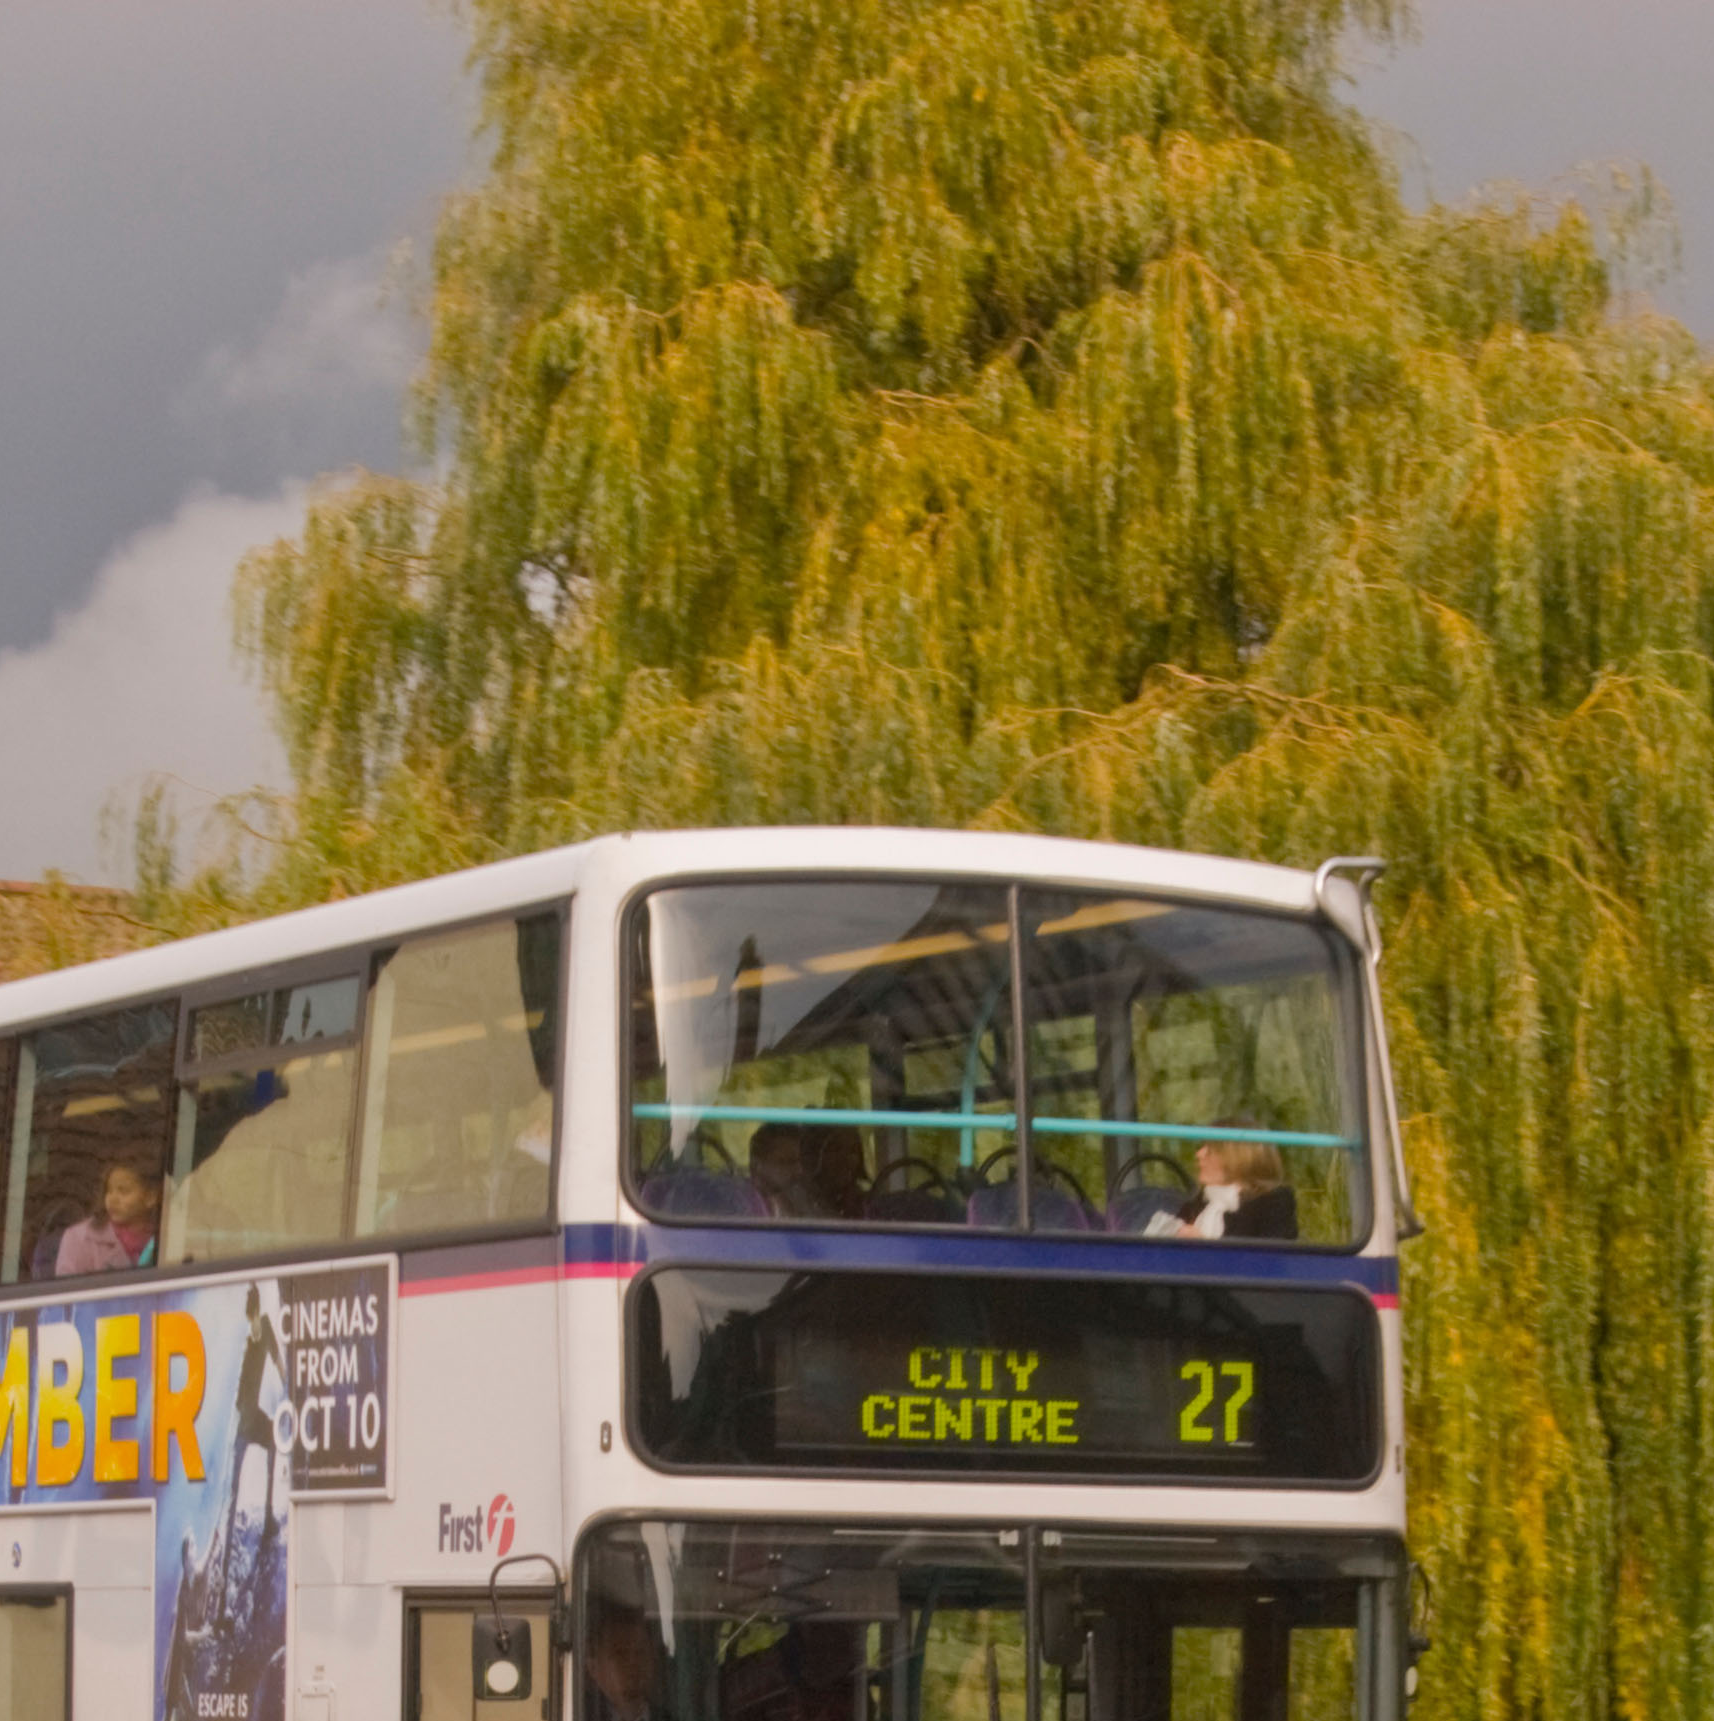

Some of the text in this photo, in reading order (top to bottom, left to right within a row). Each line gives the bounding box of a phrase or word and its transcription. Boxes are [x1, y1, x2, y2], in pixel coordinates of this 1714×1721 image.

[278, 1294, 378, 1344] CINEMAS
[296, 1344, 359, 1387] FROM
[909, 1346, 1039, 1392] CITY
[273, 1392, 381, 1455] OCT 10
[862, 1395, 1080, 1444] CENTRE
[1180, 1360, 1254, 1443] 27
[439, 1502, 484, 1553] First
[198, 1693, 249, 1718] ESCAPE IS
